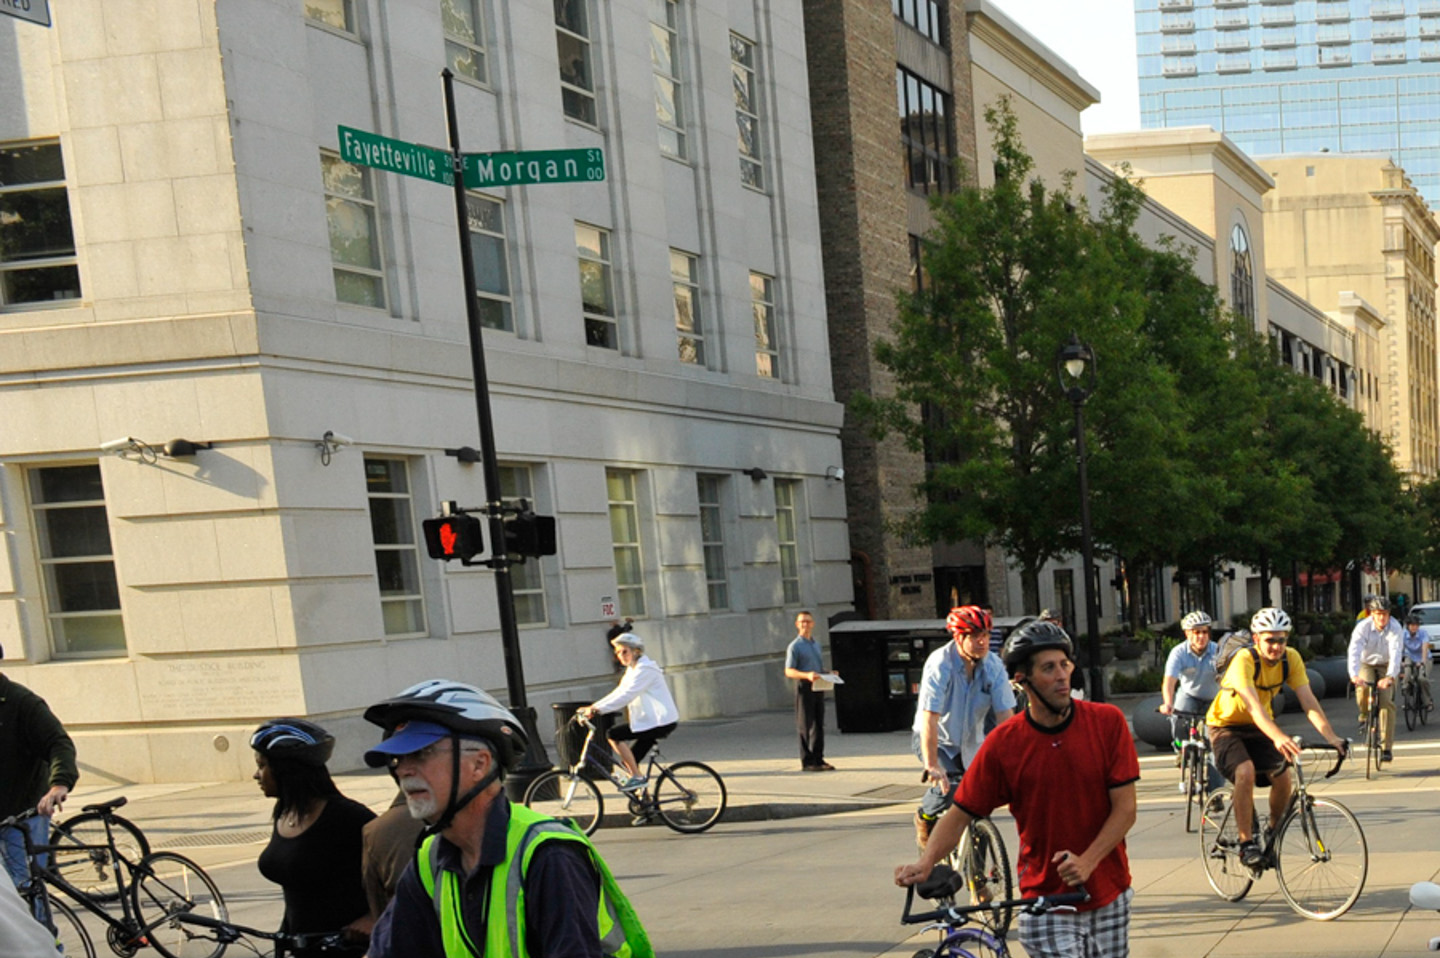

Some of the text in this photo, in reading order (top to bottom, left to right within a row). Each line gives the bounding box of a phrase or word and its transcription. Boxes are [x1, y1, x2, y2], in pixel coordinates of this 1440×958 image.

[343, 131, 436, 178] Fayetteville
[477, 158, 578, 183] Morgan
[586, 150, 601, 163] St
[586, 167, 603, 180] 00
